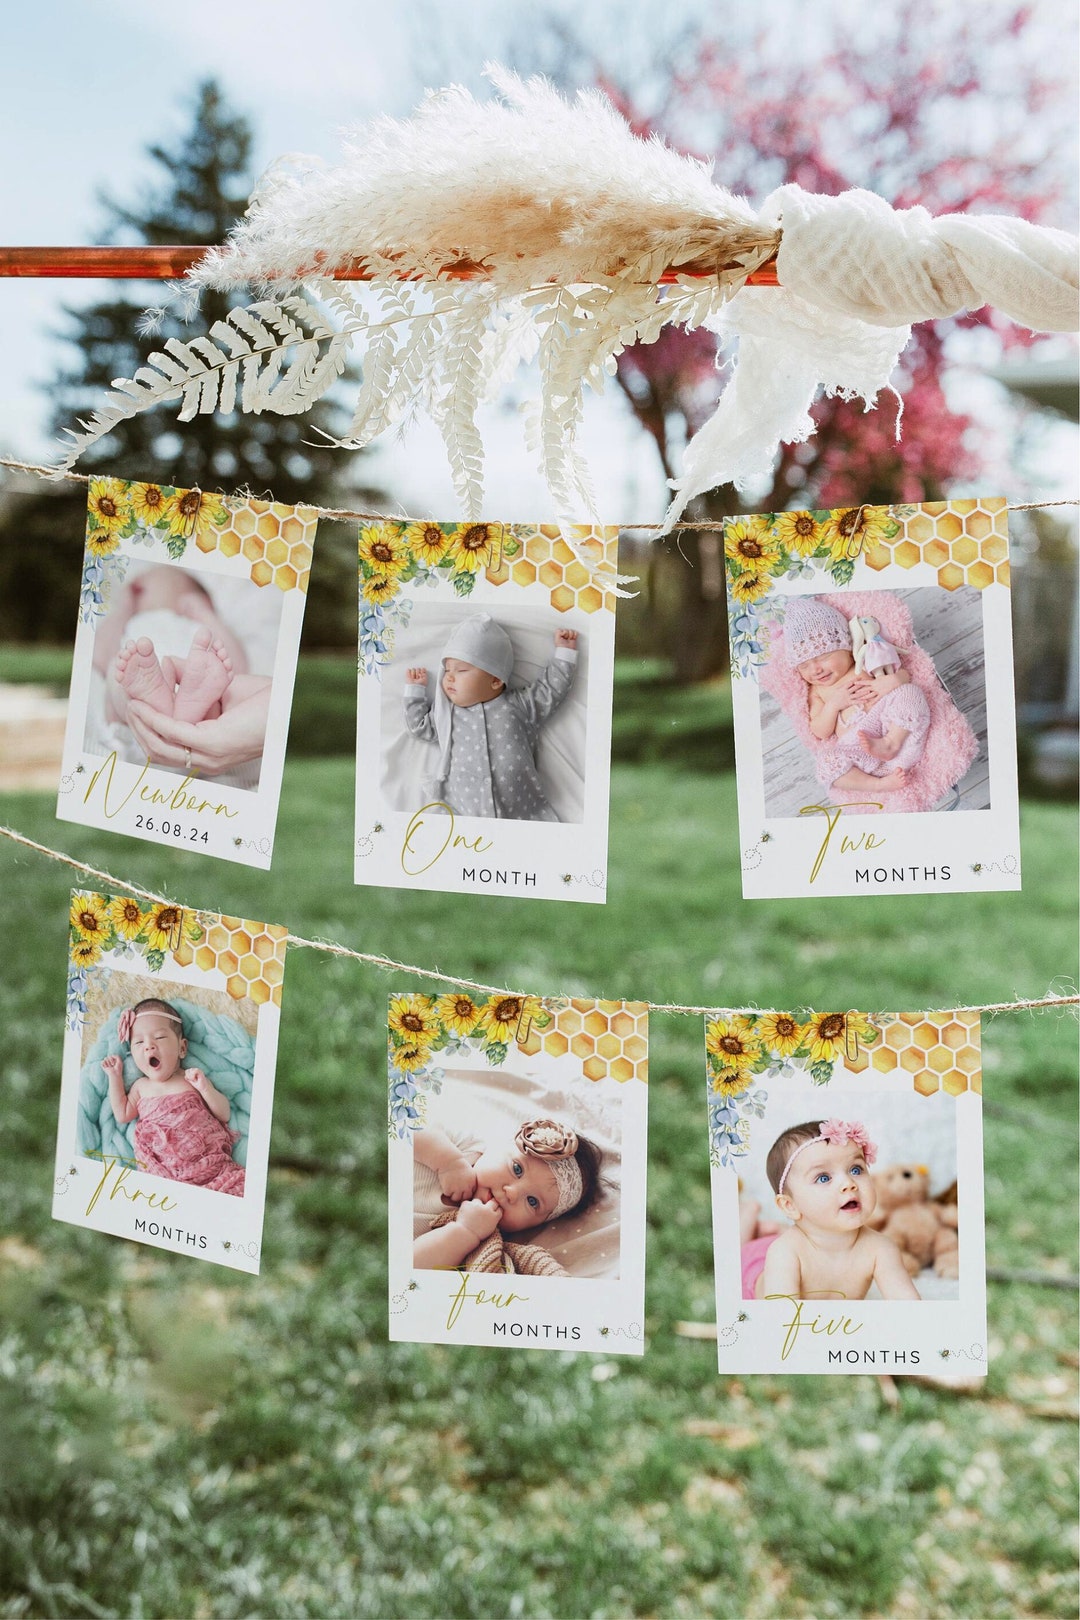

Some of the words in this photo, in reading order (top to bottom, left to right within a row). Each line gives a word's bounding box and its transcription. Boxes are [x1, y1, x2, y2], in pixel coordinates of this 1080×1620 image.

[84, 750, 238, 818] Newborn
[135, 814, 209, 844] 26.08.24
[401, 802, 493, 875] One
[800, 802, 886, 883] Two
[462, 868, 536, 886] MONTH
[855, 865, 951, 883] MONTHS
[85, 1149, 178, 1216] Three
[134, 1218, 207, 1249] MONTHS
[432, 1263, 529, 1330] Four
[493, 1322, 581, 1340] MONTHS
[764, 1290, 863, 1360] Five
[828, 1350, 921, 1364] MONTHS
